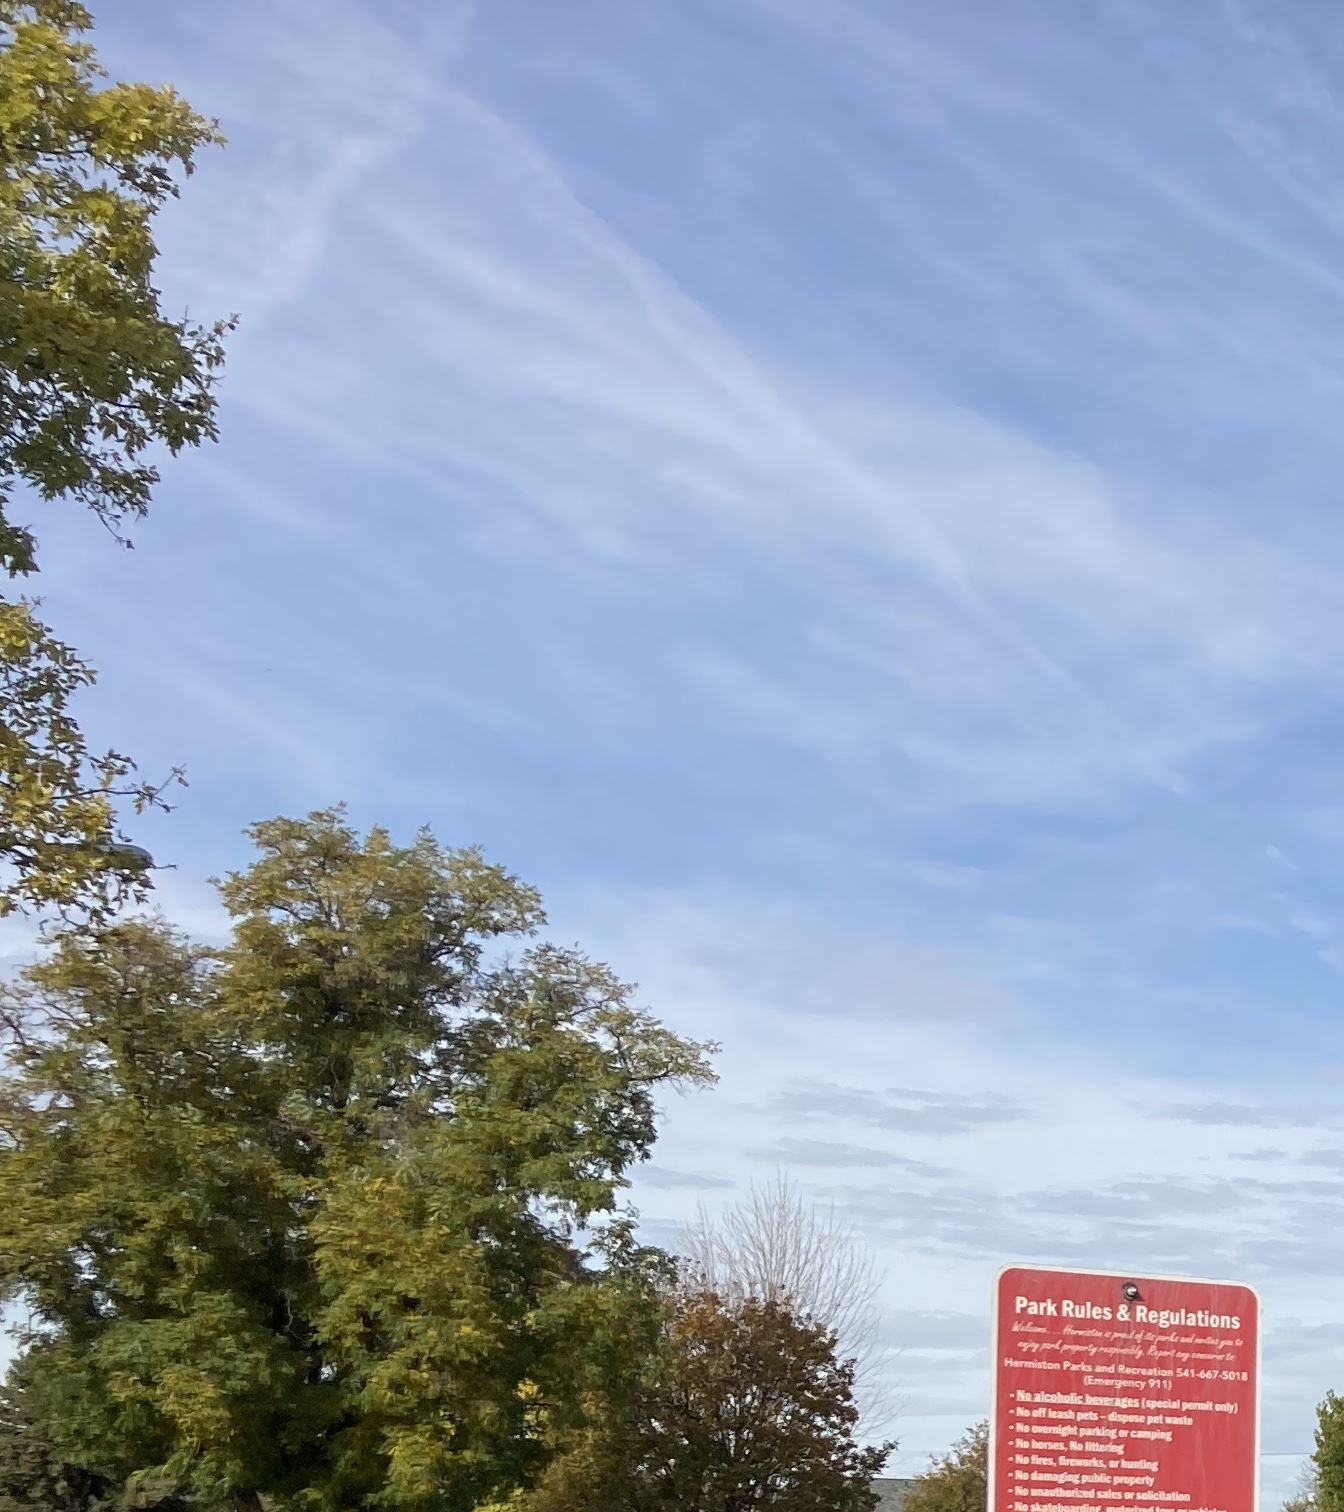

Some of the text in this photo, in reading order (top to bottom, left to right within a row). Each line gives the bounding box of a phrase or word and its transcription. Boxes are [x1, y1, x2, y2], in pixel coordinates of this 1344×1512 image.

[1015, 1296, 1240, 1329] Park Rules & Regulations
[1175, 1367, 1248, 1381] 541-667-5018
